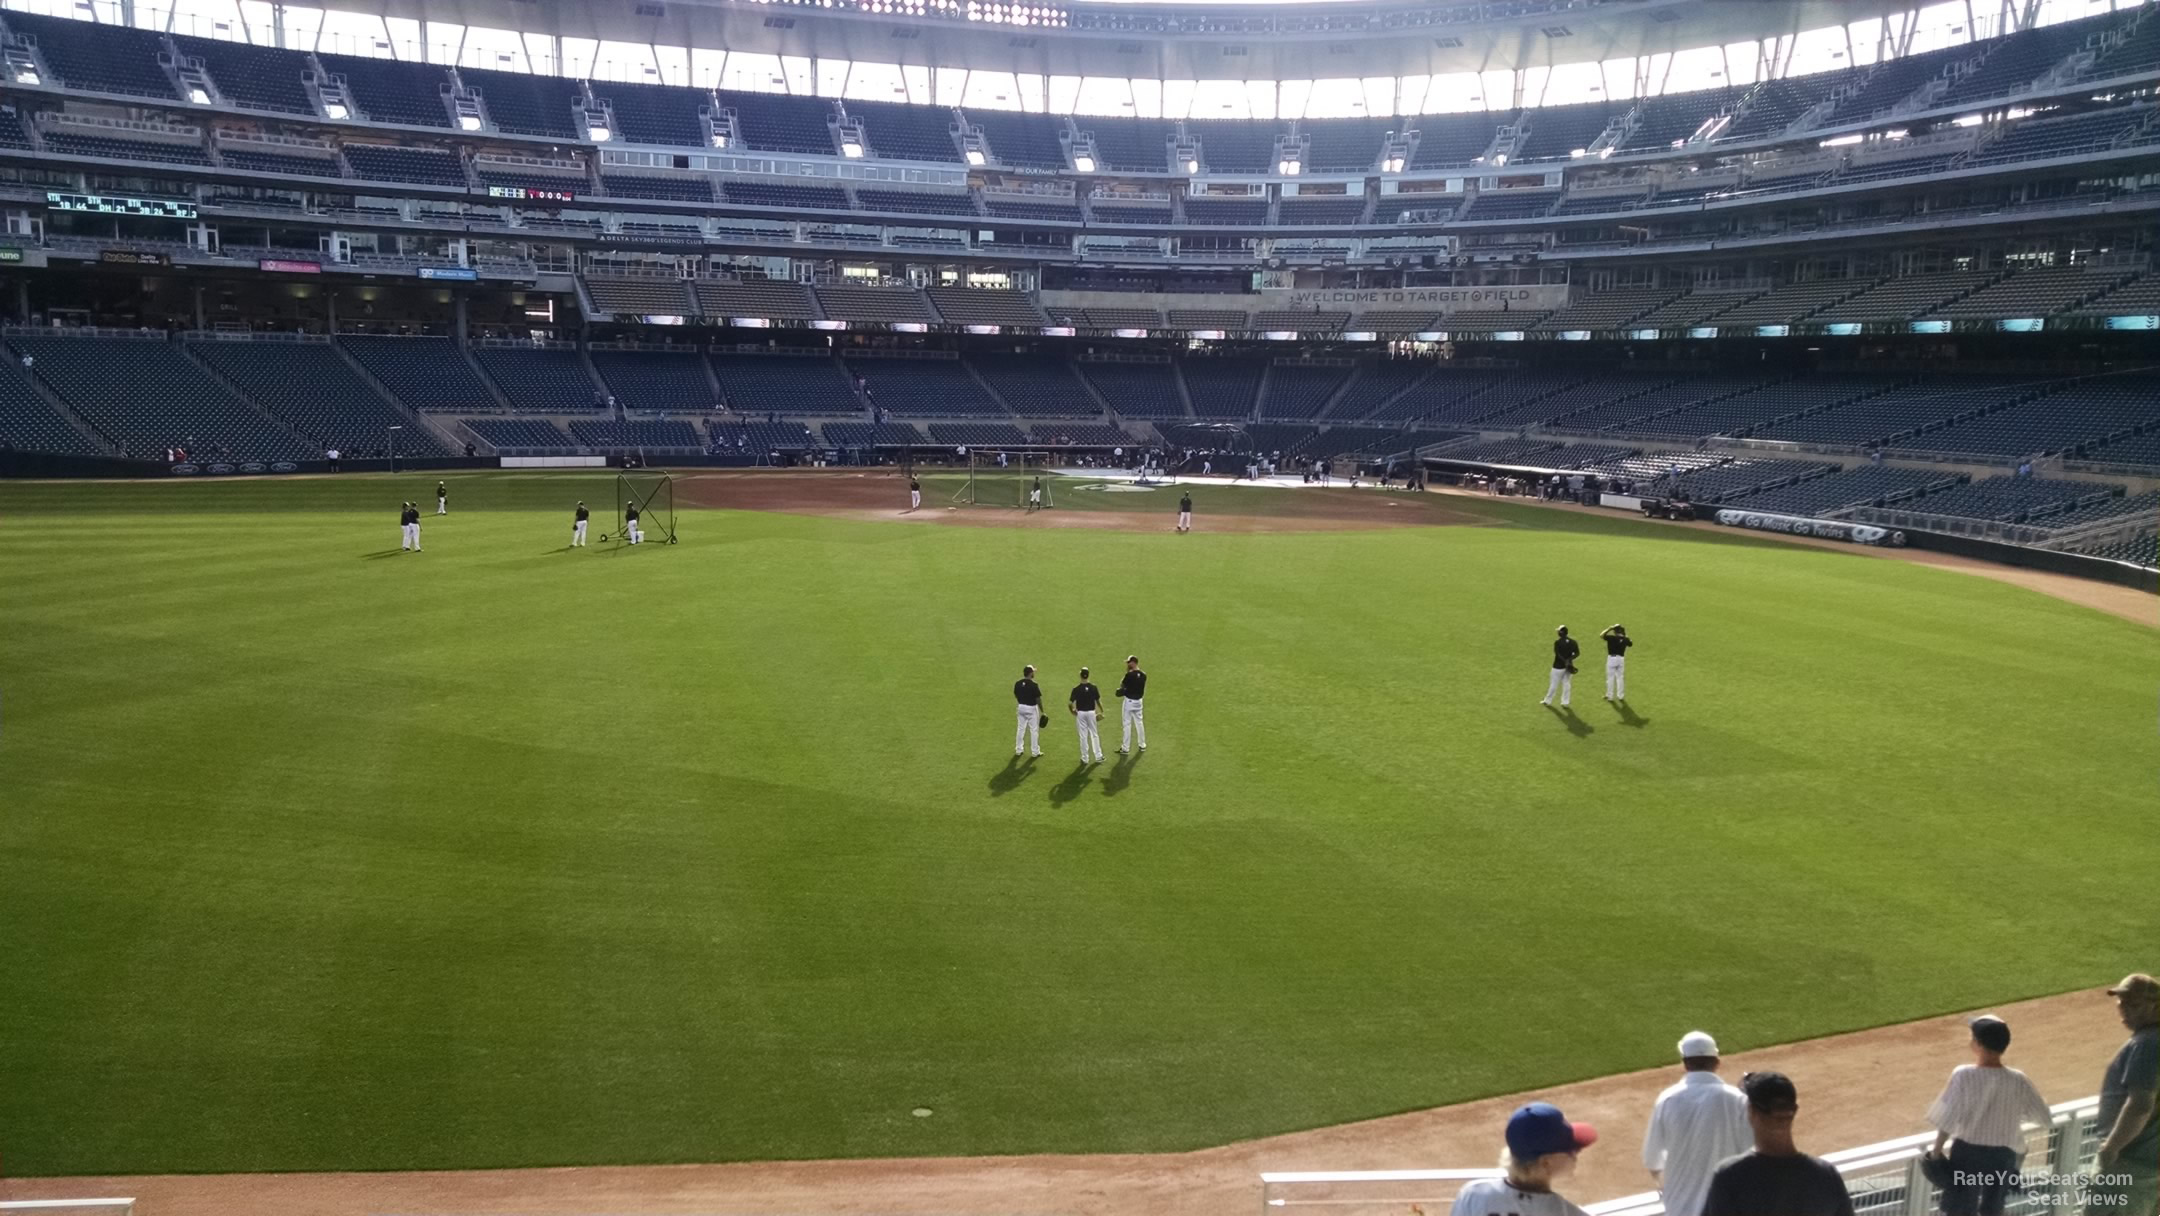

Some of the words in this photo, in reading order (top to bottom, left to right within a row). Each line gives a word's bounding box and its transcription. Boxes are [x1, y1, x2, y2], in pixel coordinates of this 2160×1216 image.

[1298, 292, 1378, 302] WELCOME
[1382, 292, 1404, 302] TO
[1408, 291, 1469, 302] TARGET
[1485, 290, 1530, 301] FIELD
[1745, 515, 1760, 527] Go
[1761, 517, 1791, 533] Music
[1793, 522, 1810, 535] Go
[1812, 523, 1845, 539] Twins
